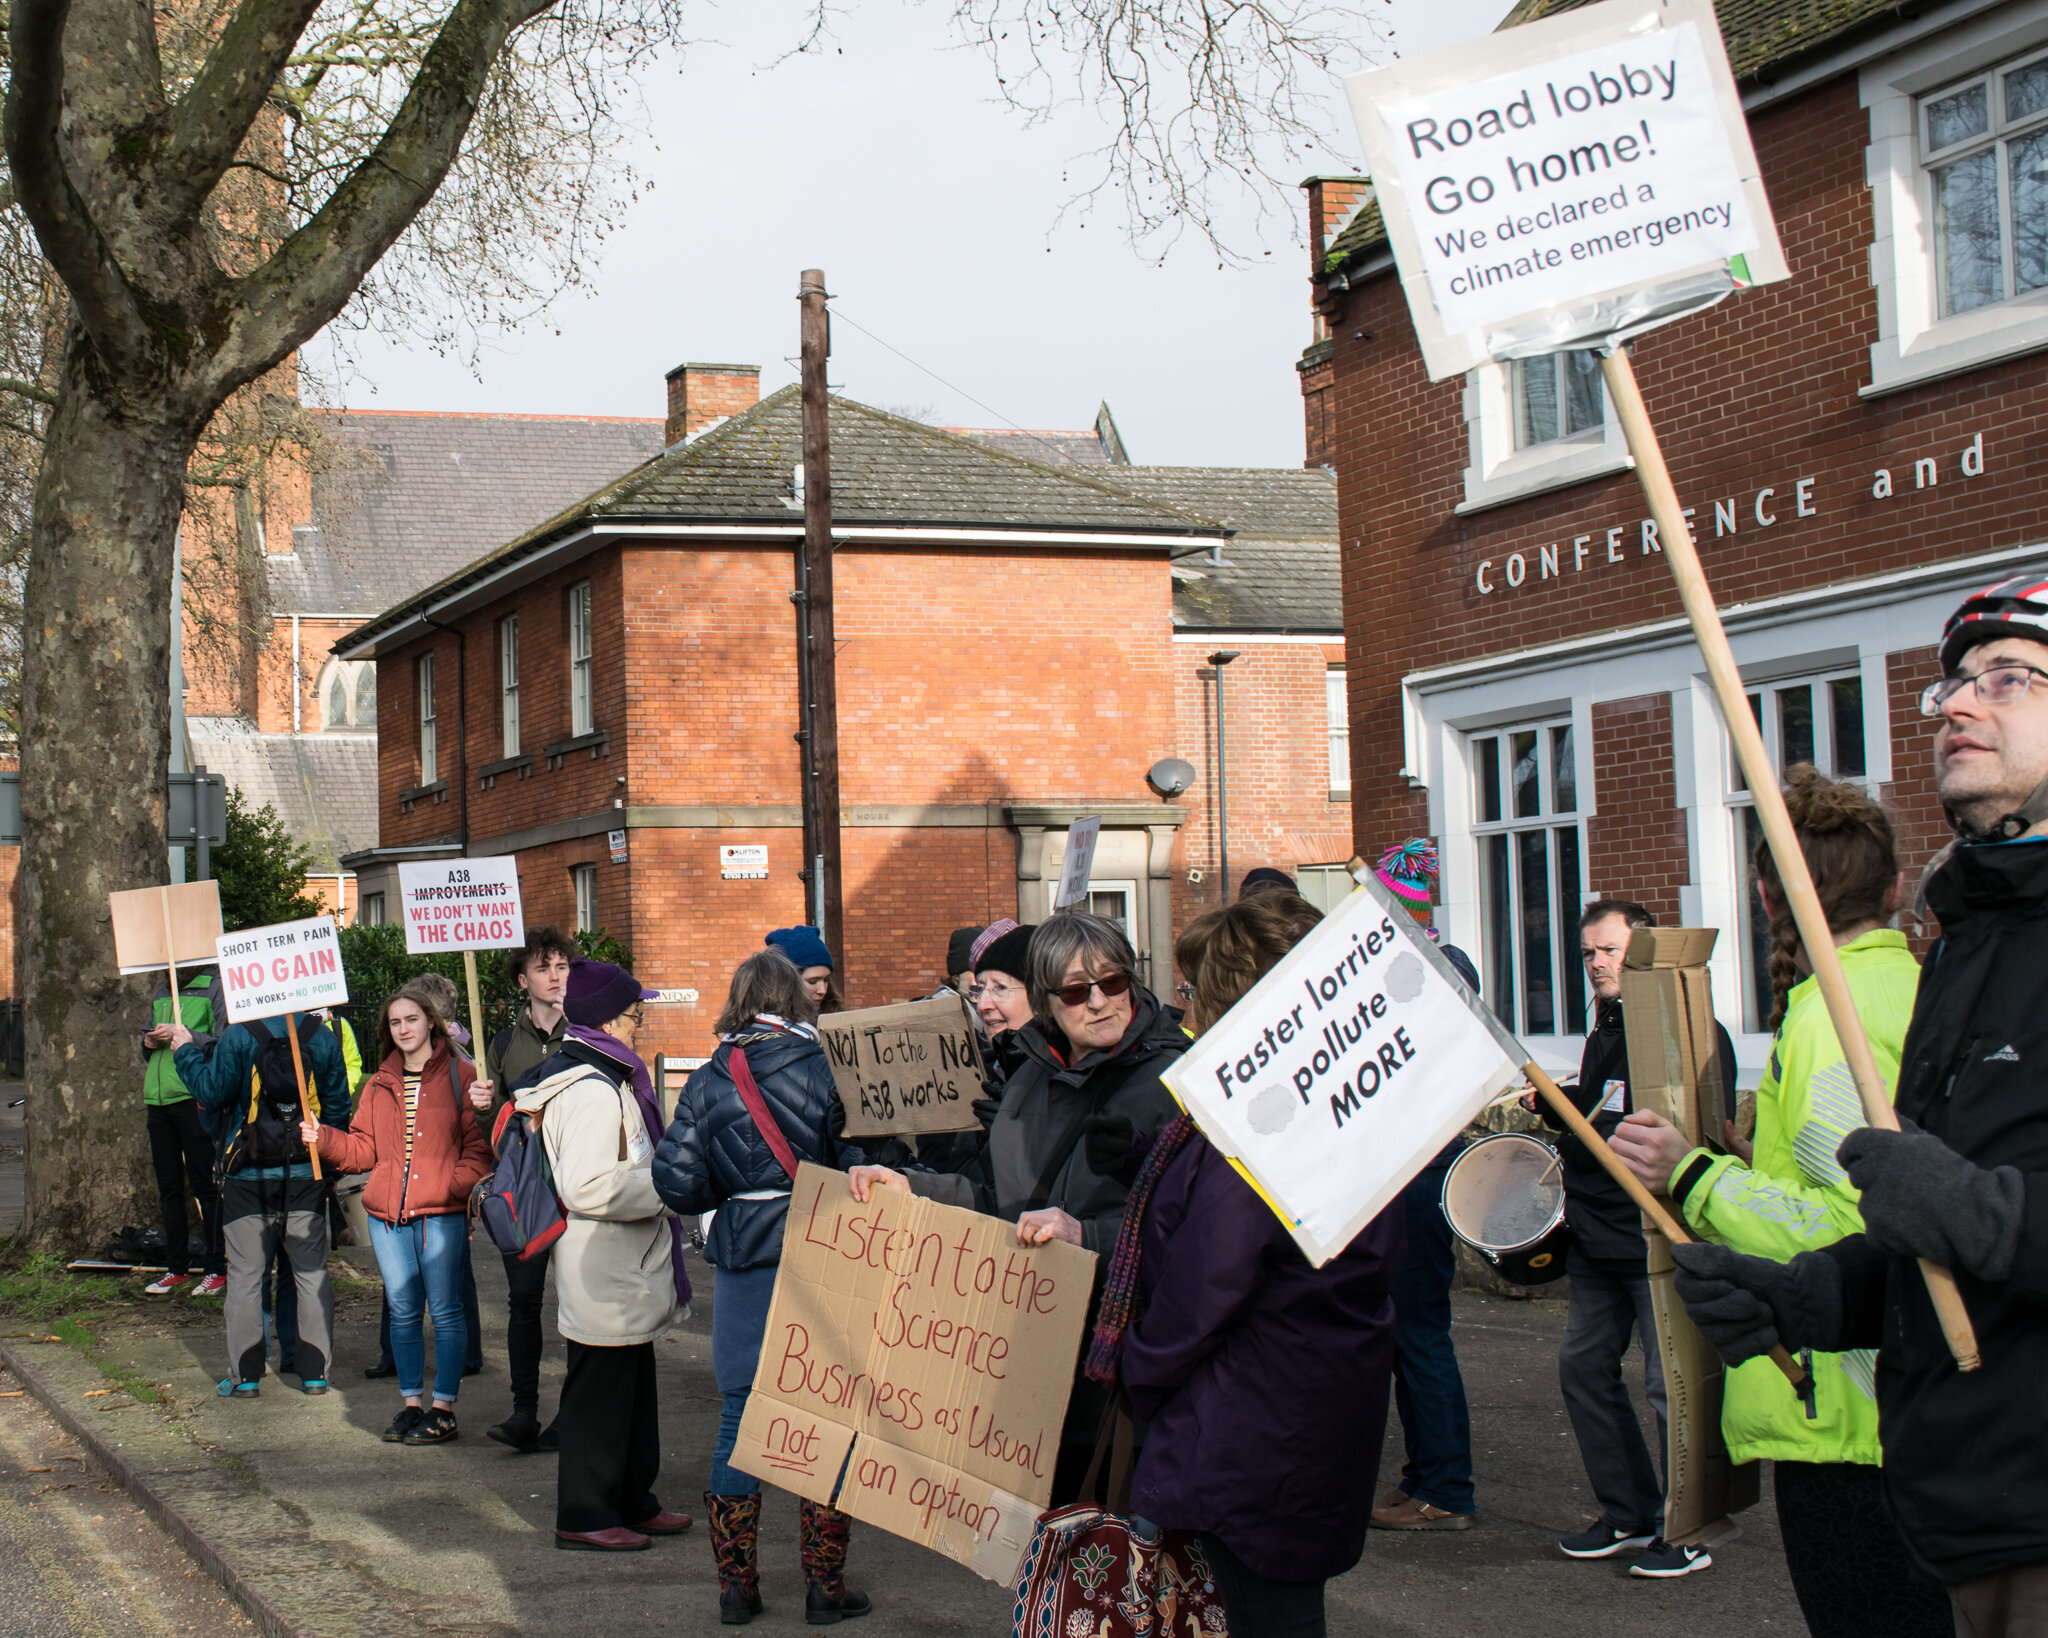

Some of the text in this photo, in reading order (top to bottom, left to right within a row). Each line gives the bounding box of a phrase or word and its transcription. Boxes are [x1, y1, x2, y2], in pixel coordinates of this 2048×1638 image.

[1406, 60, 1677, 159] Road lobby
[1424, 119, 1657, 215] Go home!
[1434, 183, 1656, 259] We declared a
[1449, 201, 1732, 296] climate emergency
[1872, 432, 1985, 500] and
[410, 902, 515, 921] WE DON'T WANT
[415, 882, 507, 901] IMPROVEMENTS
[448, 869, 471, 883] A38
[222, 926, 331, 957] SHORT TERM PAIN
[417, 919, 513, 943] THE CHAOS
[227, 948, 336, 991] NO GAIN
[235, 998, 251, 1009] A38
[256, 992, 287, 1005] WORKS
[295, 987, 308, 997] NO
[312, 982, 337, 995] POINT
[897, 1028, 928, 1063] the
[1215, 916, 1396, 1100] Faster lorries
[1292, 993, 1387, 1105] pollute
[1330, 1026, 1417, 1128] MORE
[860, 1069, 959, 1120] A38 works
[805, 1182, 1057, 1313] Listen to the
[874, 1281, 1009, 1379] Science
[778, 1323, 1044, 1478] Business as Usual
[766, 1417, 1000, 1542] not an option
